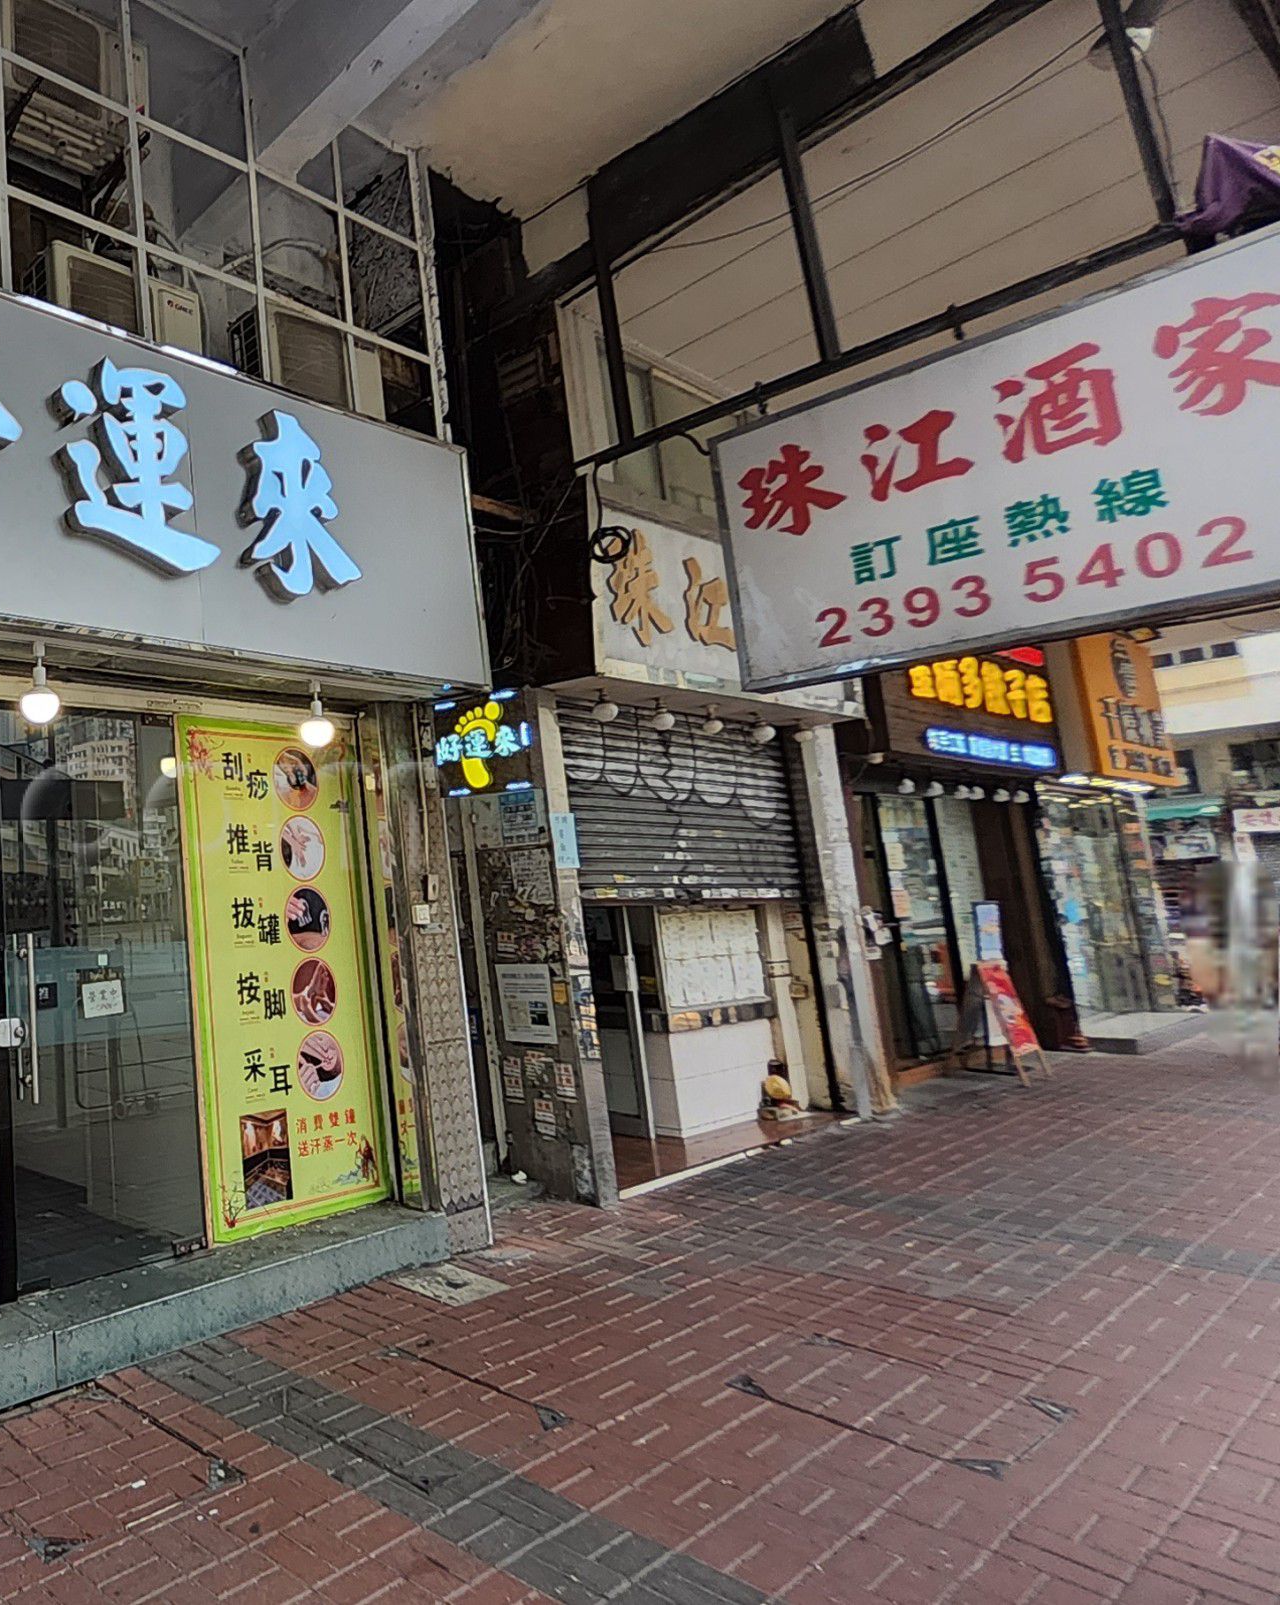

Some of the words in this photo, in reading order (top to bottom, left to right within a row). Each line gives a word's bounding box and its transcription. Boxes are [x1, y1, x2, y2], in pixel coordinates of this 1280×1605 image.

[737, 292, 1280, 537] 珠江酒家
[850, 467, 1171, 585] 訂座熱線
[815, 575, 993, 648] 2393
[1023, 515, 1255, 602] 5402
[221, 752, 269, 801] 刮痧
[226, 823, 274, 872] 推背
[231, 896, 282, 946] 拔罐
